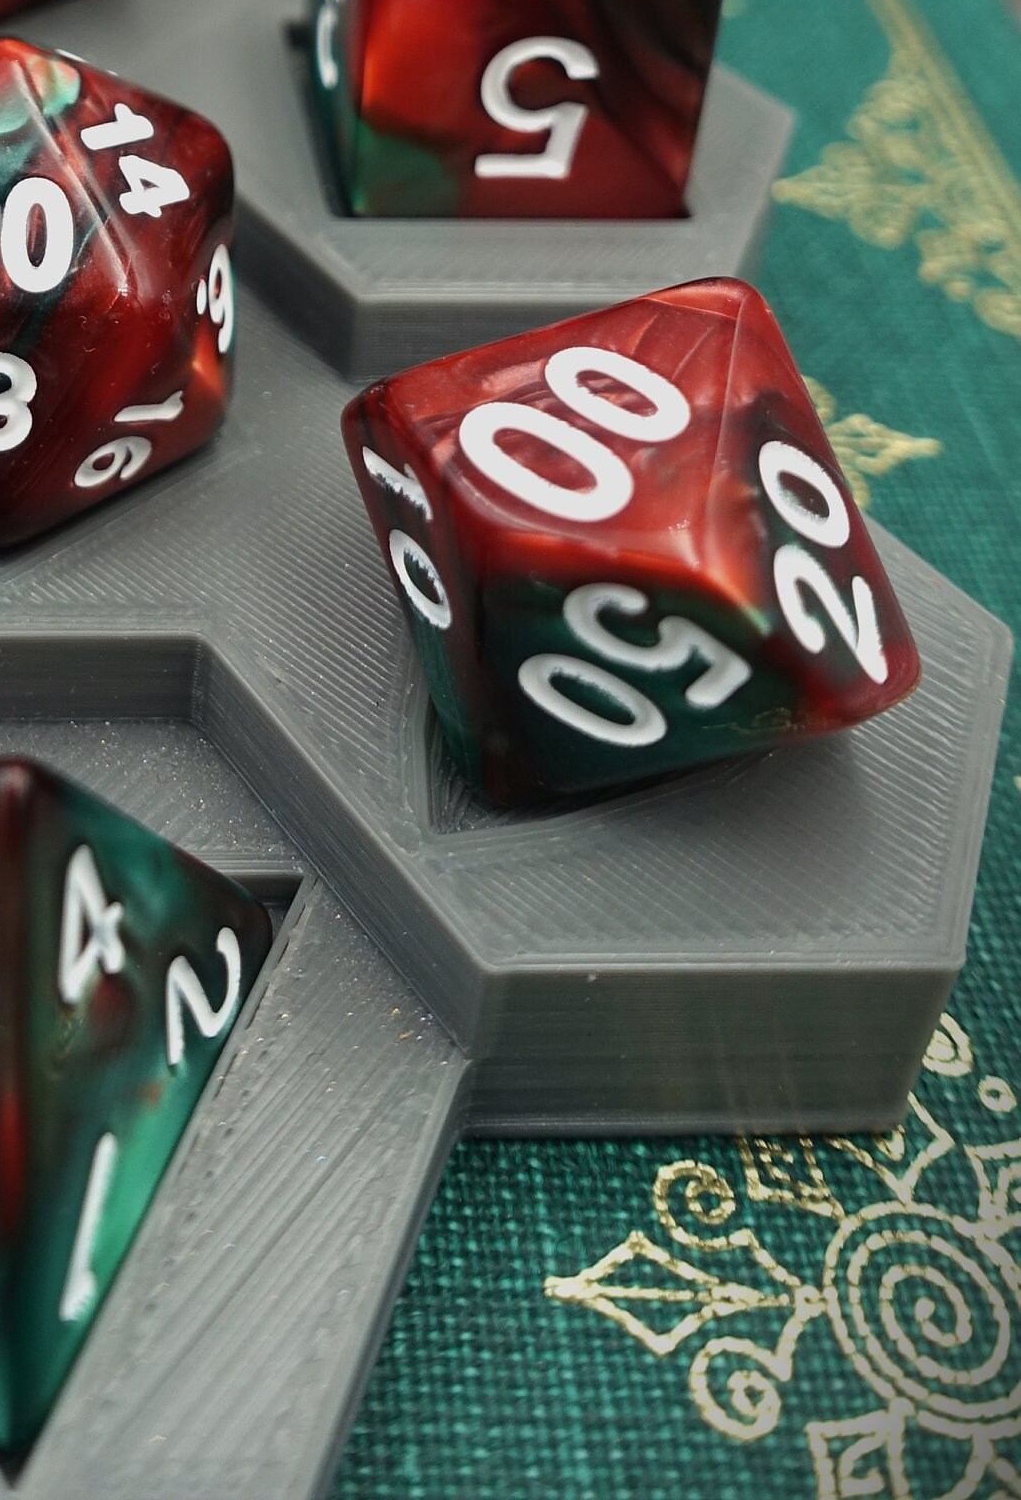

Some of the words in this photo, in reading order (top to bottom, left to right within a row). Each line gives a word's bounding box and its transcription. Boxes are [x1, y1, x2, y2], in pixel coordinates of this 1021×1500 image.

[80, 102, 191, 218] 14
[475, 38, 598, 179] 5
[74, 391, 183, 488] 16
[459, 347, 691, 521] 00
[362, 445, 452, 630] 10
[759, 440, 887, 684] 20
[518, 582, 752, 747] 50
[60, 848, 125, 1003] 4
[166, 926, 241, 1066] 2
[60, 1132, 117, 1322] 1
